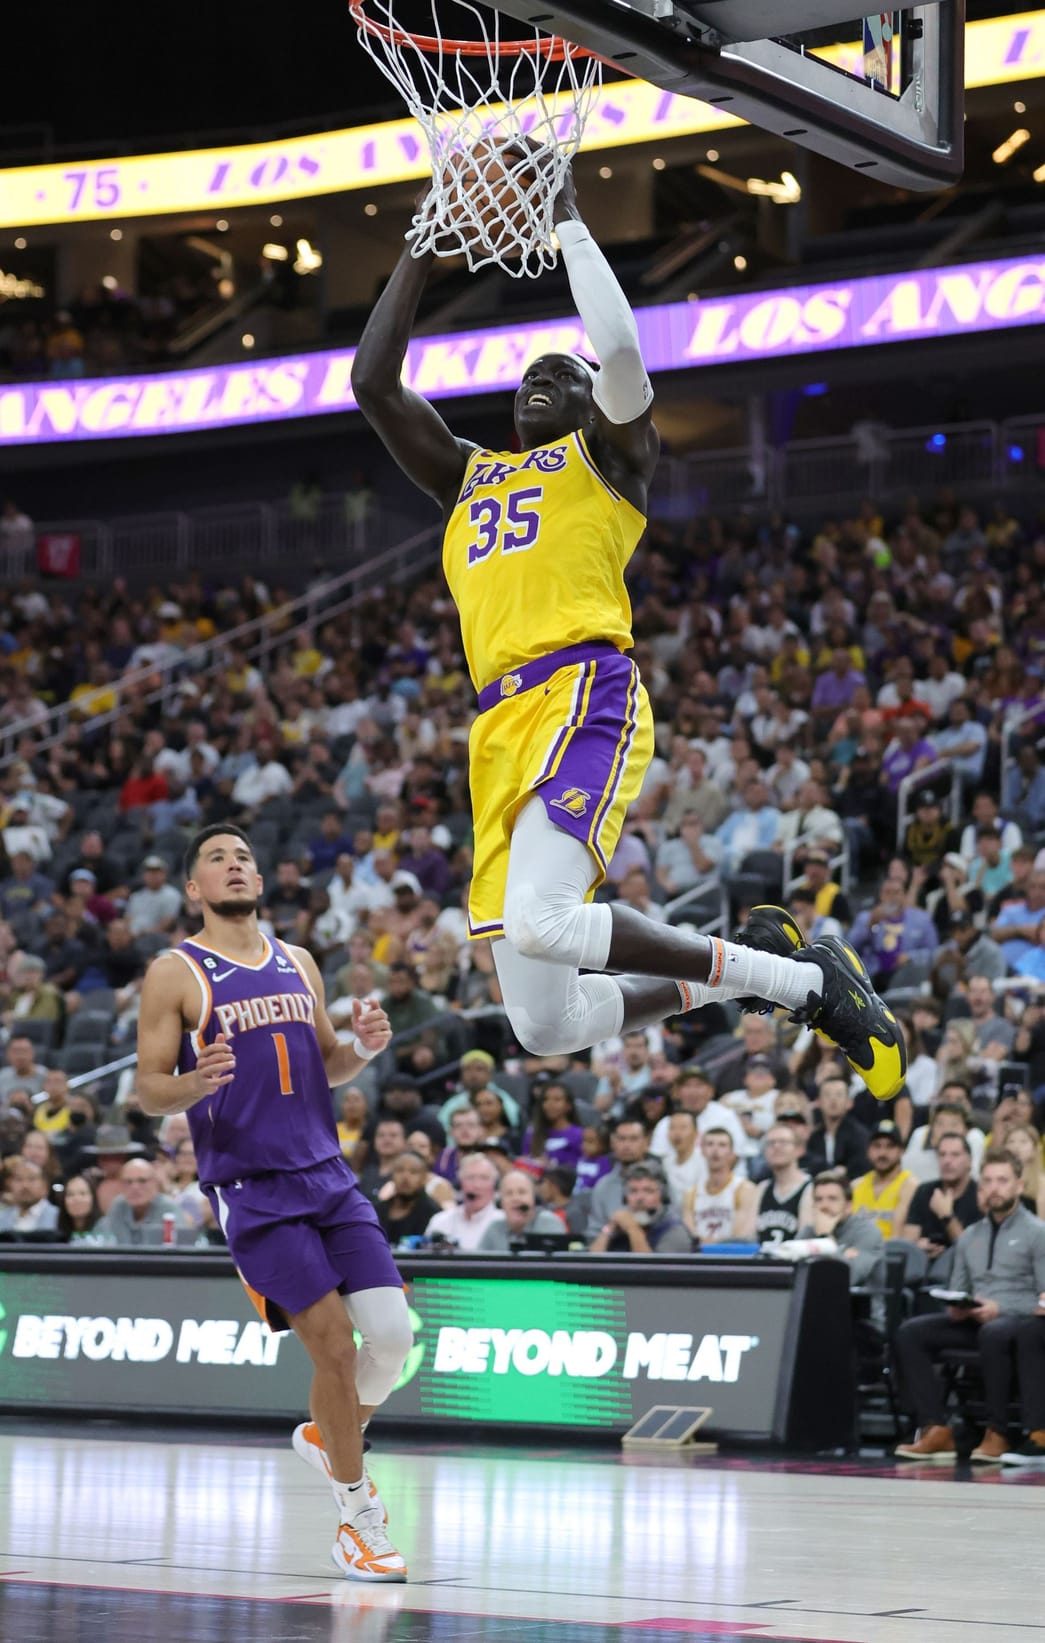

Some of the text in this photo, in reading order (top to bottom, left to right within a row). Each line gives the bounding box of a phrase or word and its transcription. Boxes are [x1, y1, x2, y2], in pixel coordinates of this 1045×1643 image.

[63, 168, 121, 211] 75
[686, 288, 851, 360] LOS
[467, 485, 544, 570] 35
[203, 957, 218, 970] 6
[213, 992, 316, 1041] PHOENIX
[270, 1032, 295, 1096] 1
[12, 1315, 289, 1366] BEYOND MEAT
[433, 1326, 751, 1383] BEYOND MEAT
